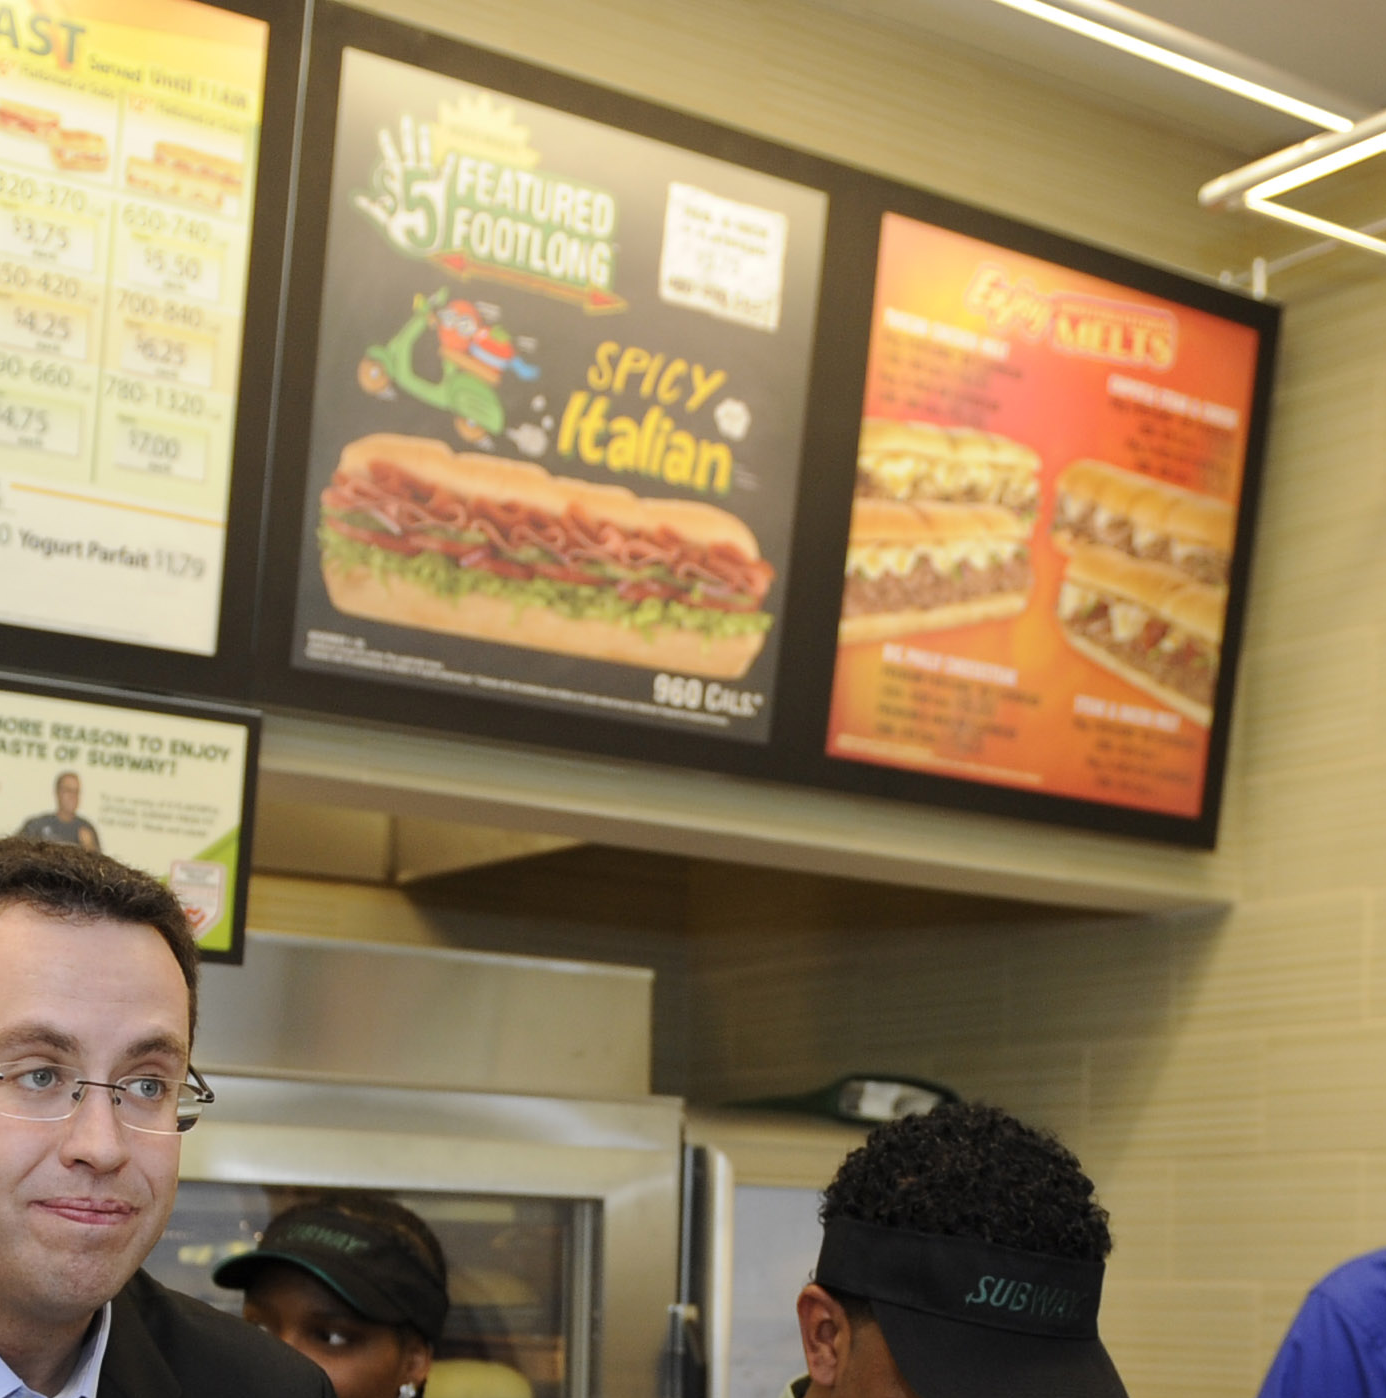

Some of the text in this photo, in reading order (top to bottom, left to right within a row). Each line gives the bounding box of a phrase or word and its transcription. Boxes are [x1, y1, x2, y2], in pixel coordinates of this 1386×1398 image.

[456, 155, 616, 239] FEATURED
[451, 206, 612, 289] FOOTLONG
[1054, 315, 1174, 369] MELTS
[587, 341, 728, 413] SPICY
[557, 390, 734, 496] Italian
[18, 527, 151, 570] Yogurt Parfait
[652, 672, 703, 710] 960
[50, 720, 131, 749] REASON
[137, 734, 165, 753] TO
[169, 740, 232, 764] ENJOY
[53, 744, 82, 764] OF
